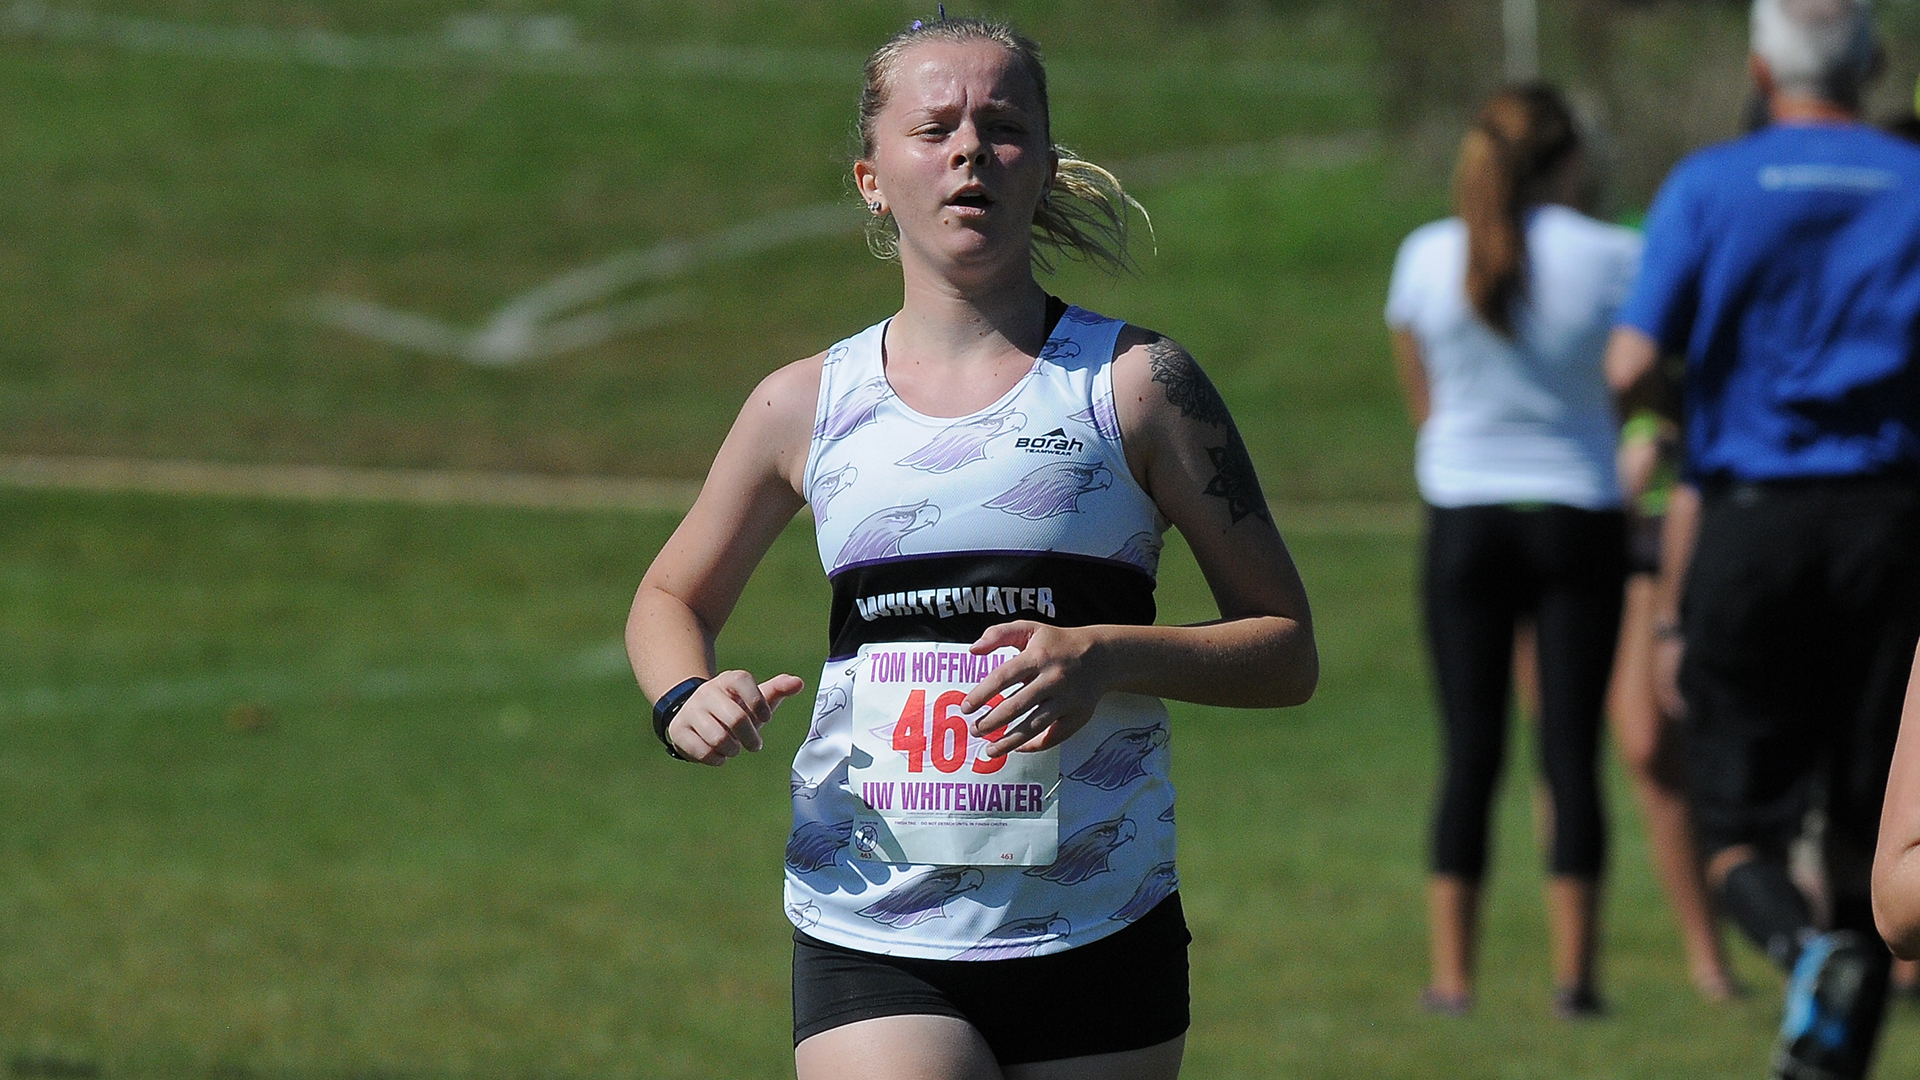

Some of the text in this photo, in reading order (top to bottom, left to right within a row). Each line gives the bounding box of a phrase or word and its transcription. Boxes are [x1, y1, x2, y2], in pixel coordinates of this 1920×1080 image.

[1025, 448, 1072, 456] TEAMWEAR
[856, 587, 1056, 622] WHITEWATER
[870, 652, 907, 683] TOM
[862, 782, 1043, 812] UW WHITEWATER
